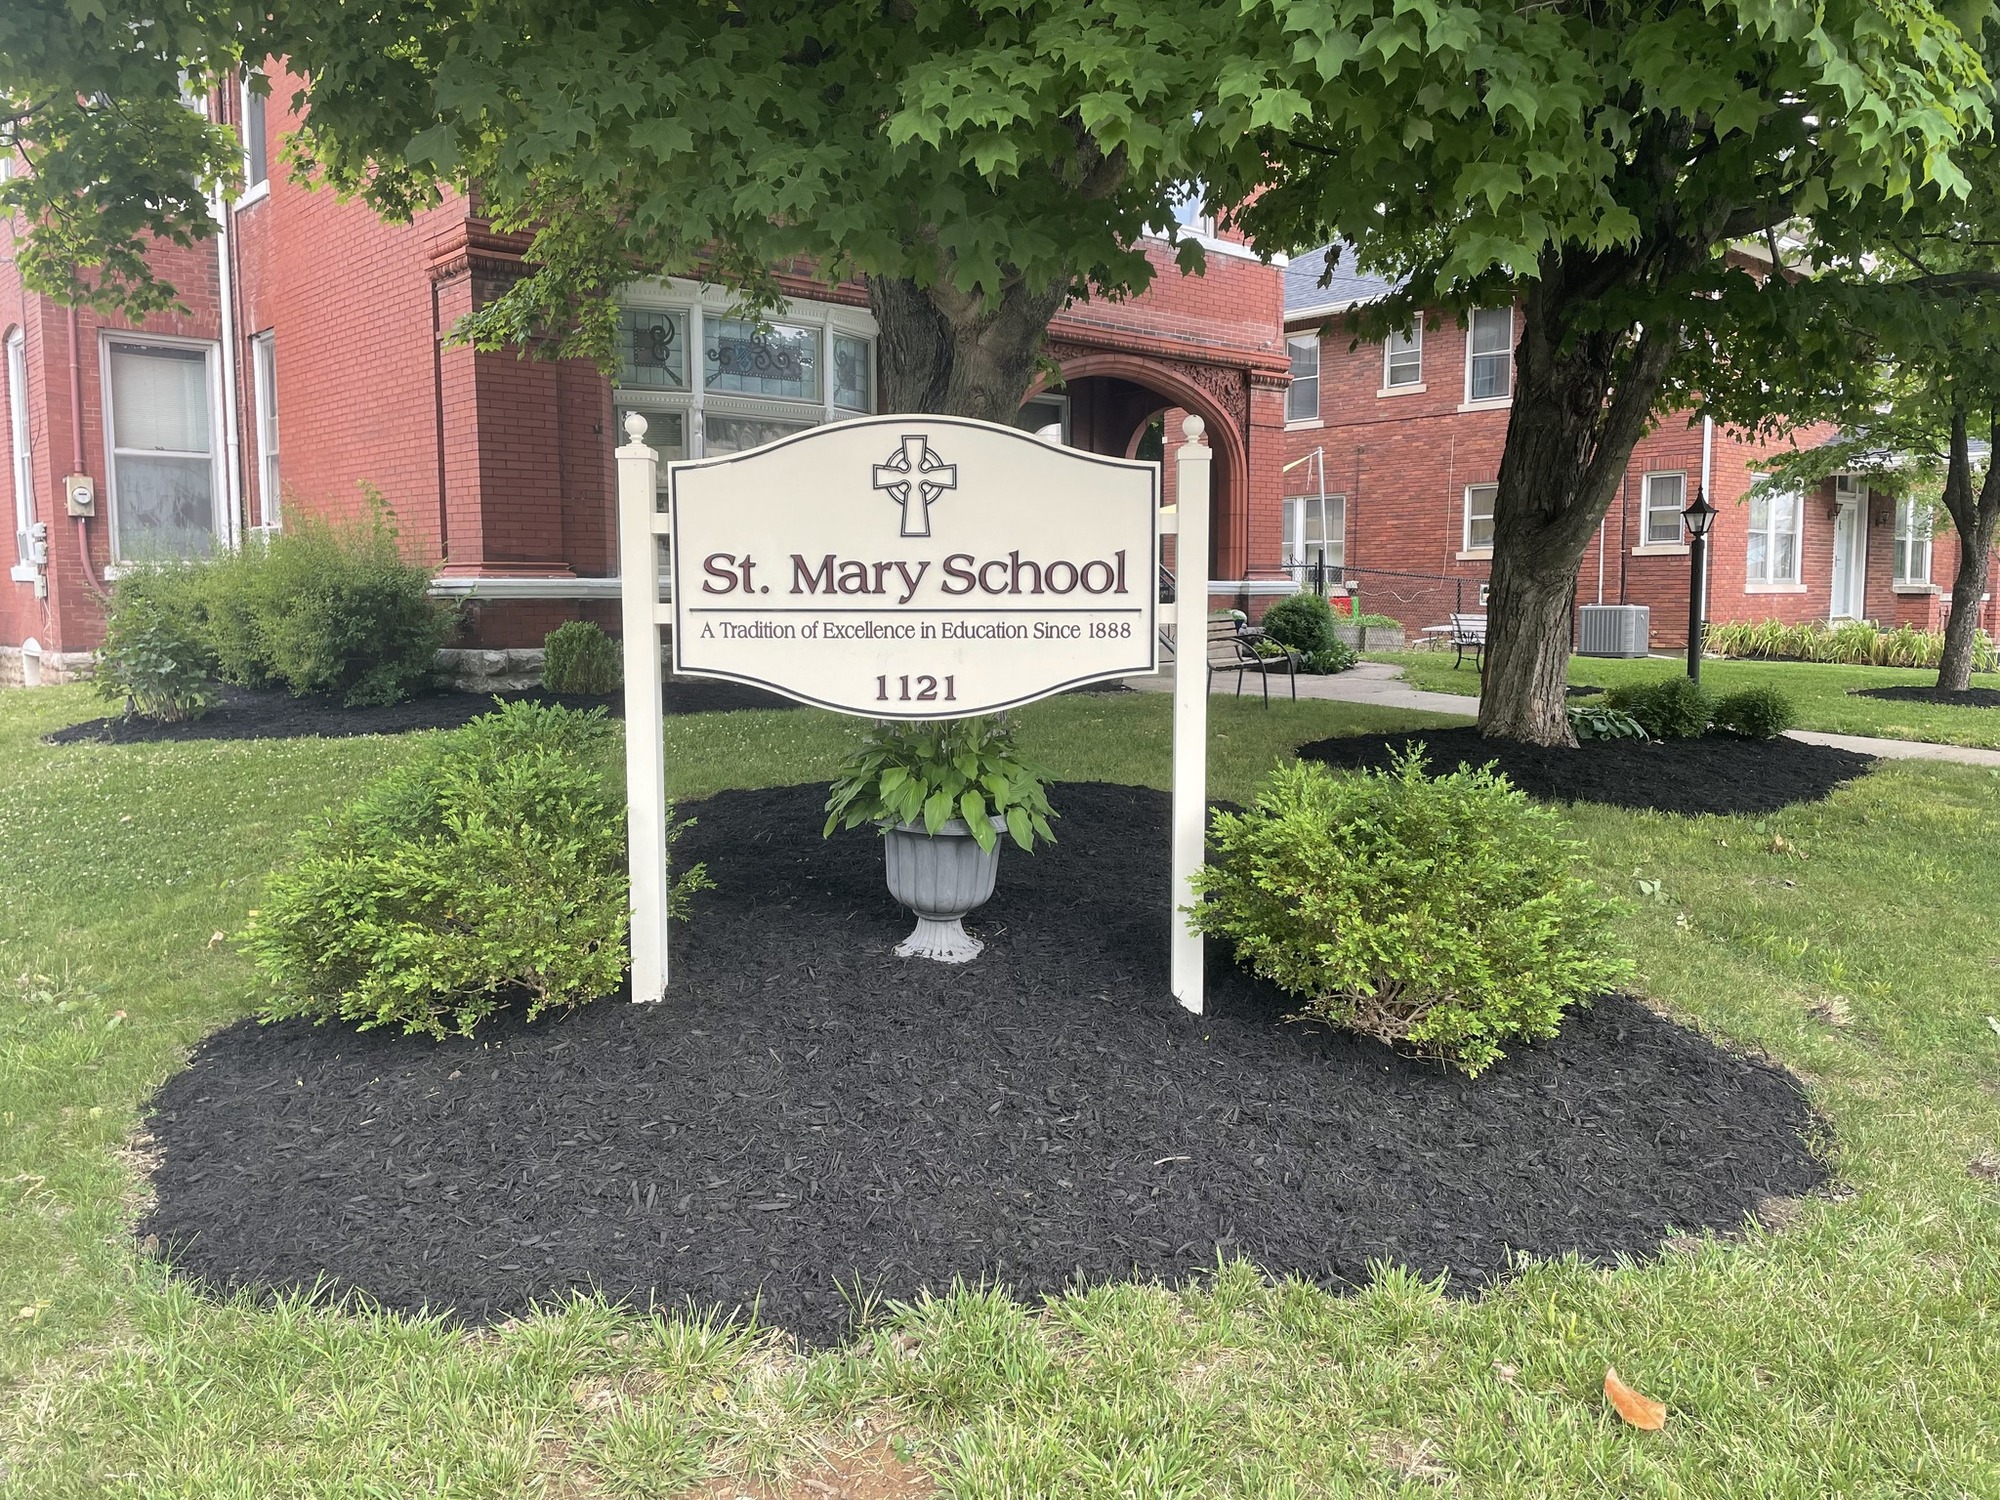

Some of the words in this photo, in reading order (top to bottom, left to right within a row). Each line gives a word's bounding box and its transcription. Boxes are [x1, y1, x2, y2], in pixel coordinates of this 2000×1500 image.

[702, 552, 770, 595] St.
[789, 553, 932, 605] Mary
[941, 549, 1129, 595] School
[700, 621, 715, 639] A
[719, 620, 796, 639] Tradition
[801, 620, 819, 639] of
[822, 620, 916, 639] Excellence
[920, 621, 937, 639] in
[941, 620, 1029, 639] Education
[1033, 621, 1081, 639] Since
[1088, 622, 1132, 639] 1888
[876, 674, 957, 701] 1121
